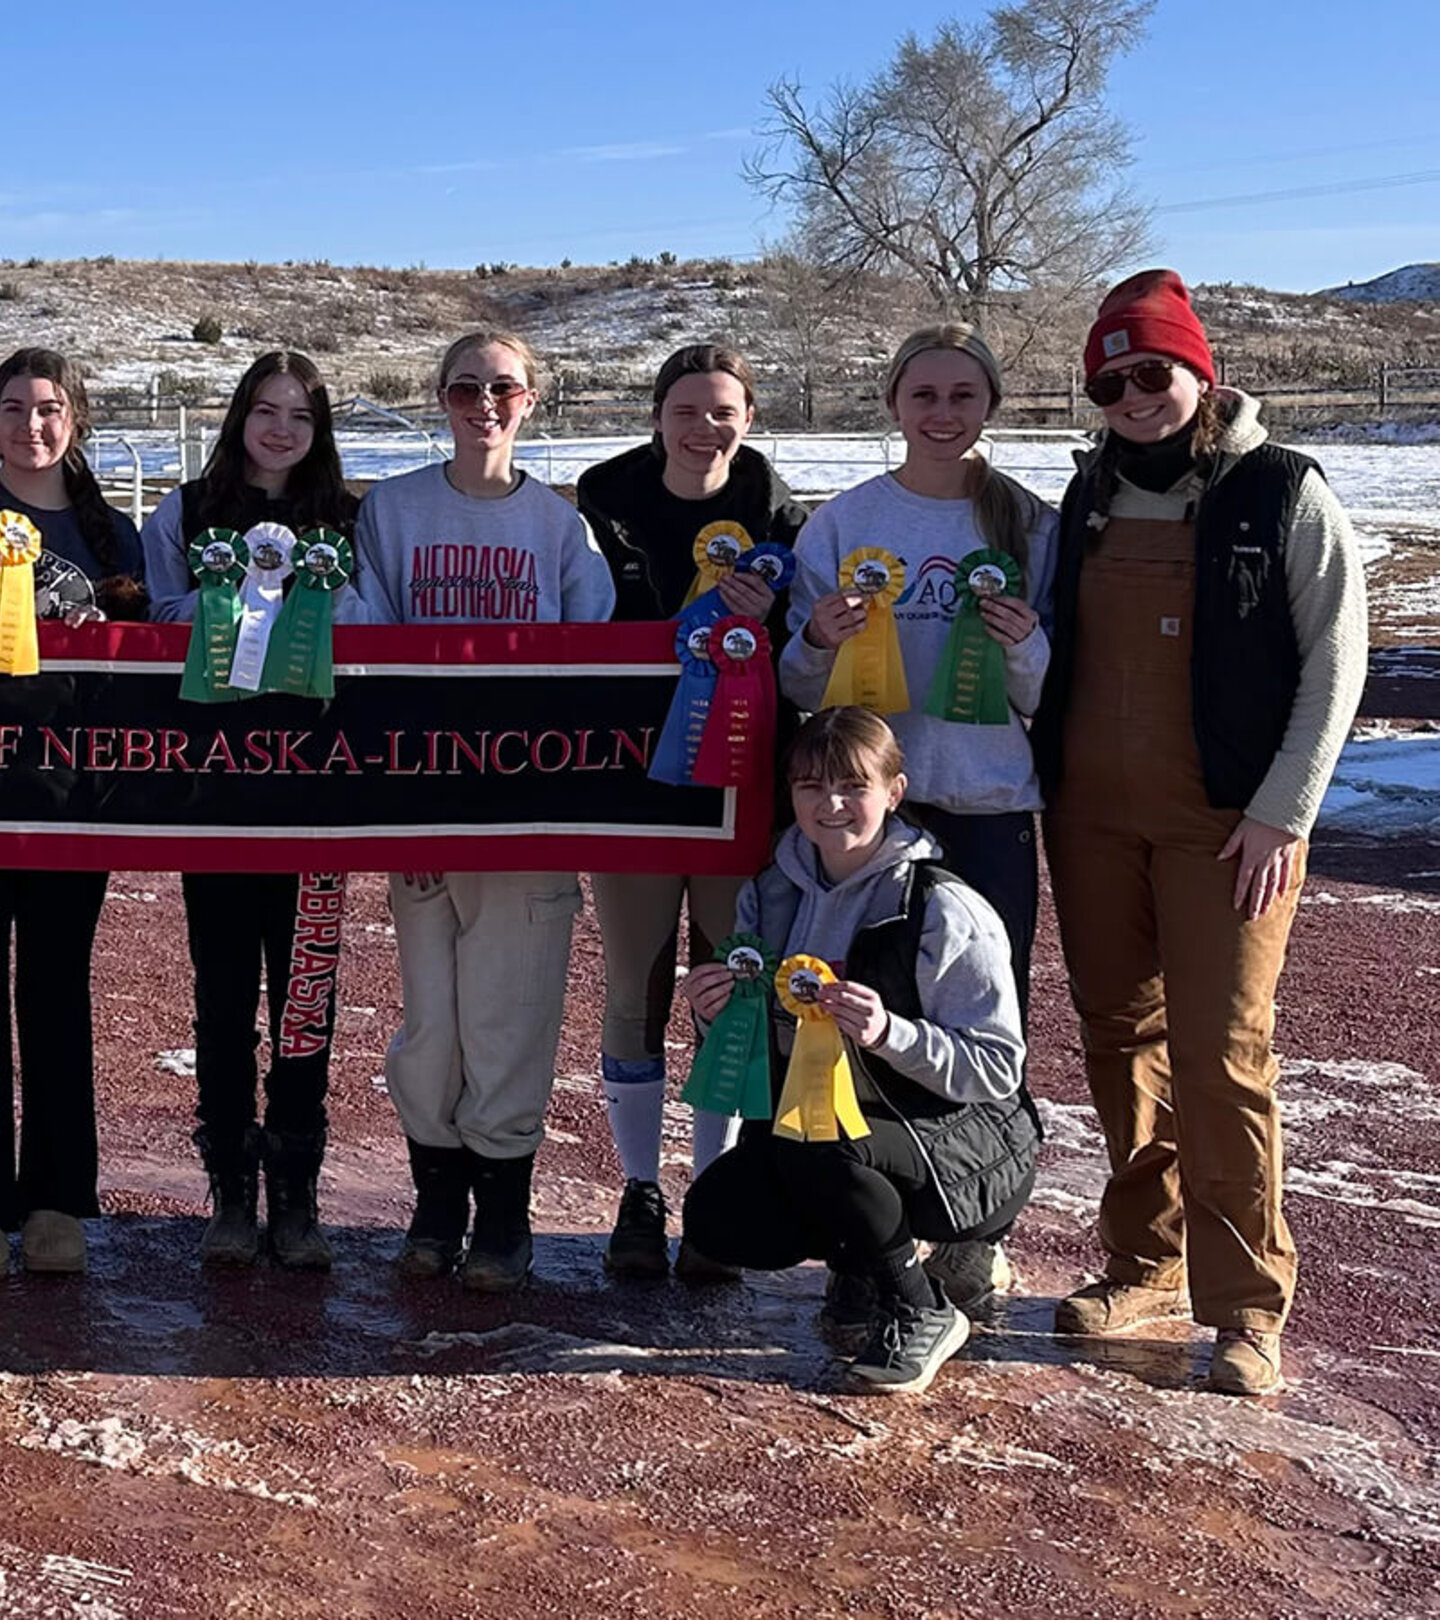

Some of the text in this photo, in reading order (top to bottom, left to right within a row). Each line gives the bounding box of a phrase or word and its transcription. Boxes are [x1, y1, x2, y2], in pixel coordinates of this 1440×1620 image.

[411, 544, 537, 621] NEBRASKA
[916, 578, 958, 613] AQ
[38, 727, 654, 775] NEBRASKA-LINCOLN
[280, 873, 345, 1058] EBRASKA
